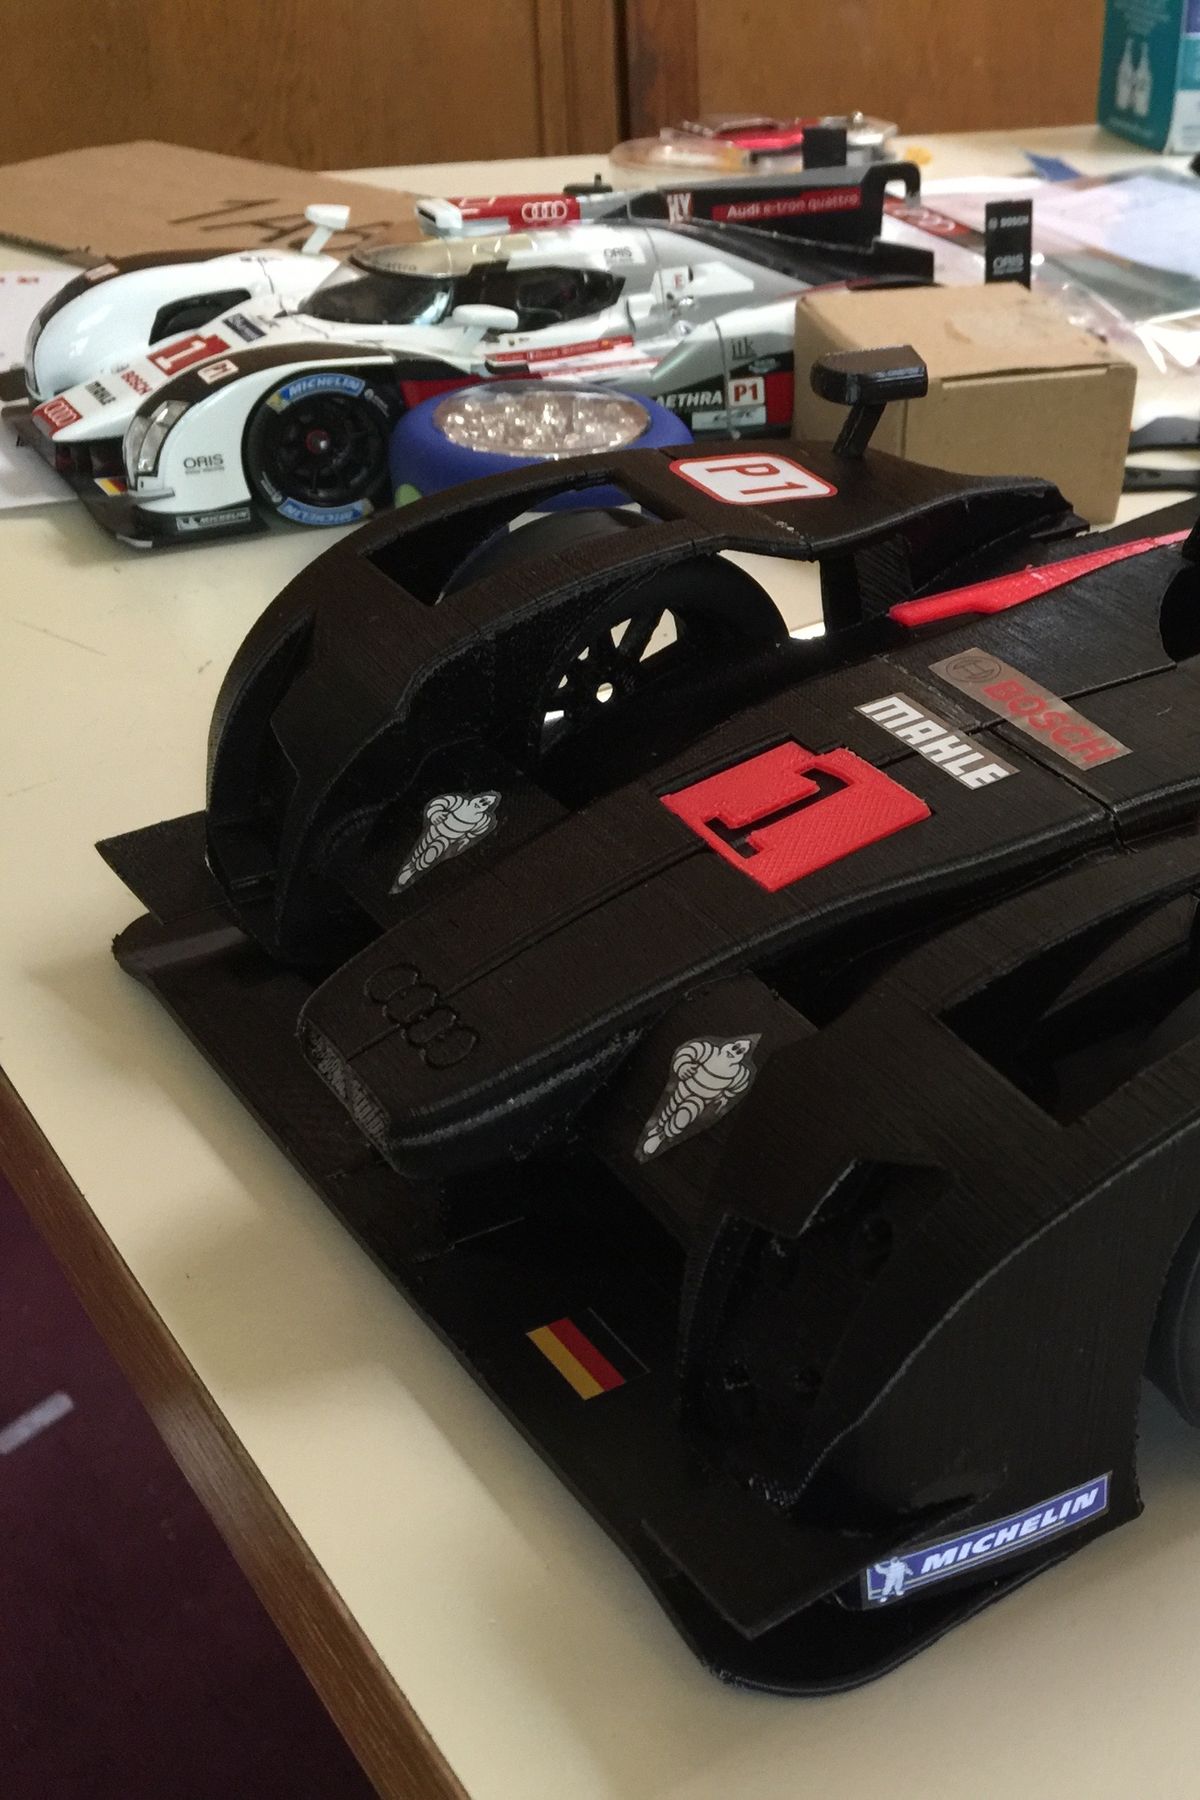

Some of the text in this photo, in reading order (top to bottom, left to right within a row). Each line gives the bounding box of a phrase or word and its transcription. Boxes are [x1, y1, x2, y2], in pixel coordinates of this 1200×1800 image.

[727, 204, 760, 219] Audi
[288, 375, 362, 398] MICHELIN
[733, 383, 758, 402] P1
[183, 453, 224, 470] ORIS
[705, 463, 808, 496] P1
[981, 678, 1121, 764] BOSCH
[859, 696, 1011, 788] MAHLE
[704, 767, 850, 858] 1
[920, 1487, 1099, 1574] MICHELIN
